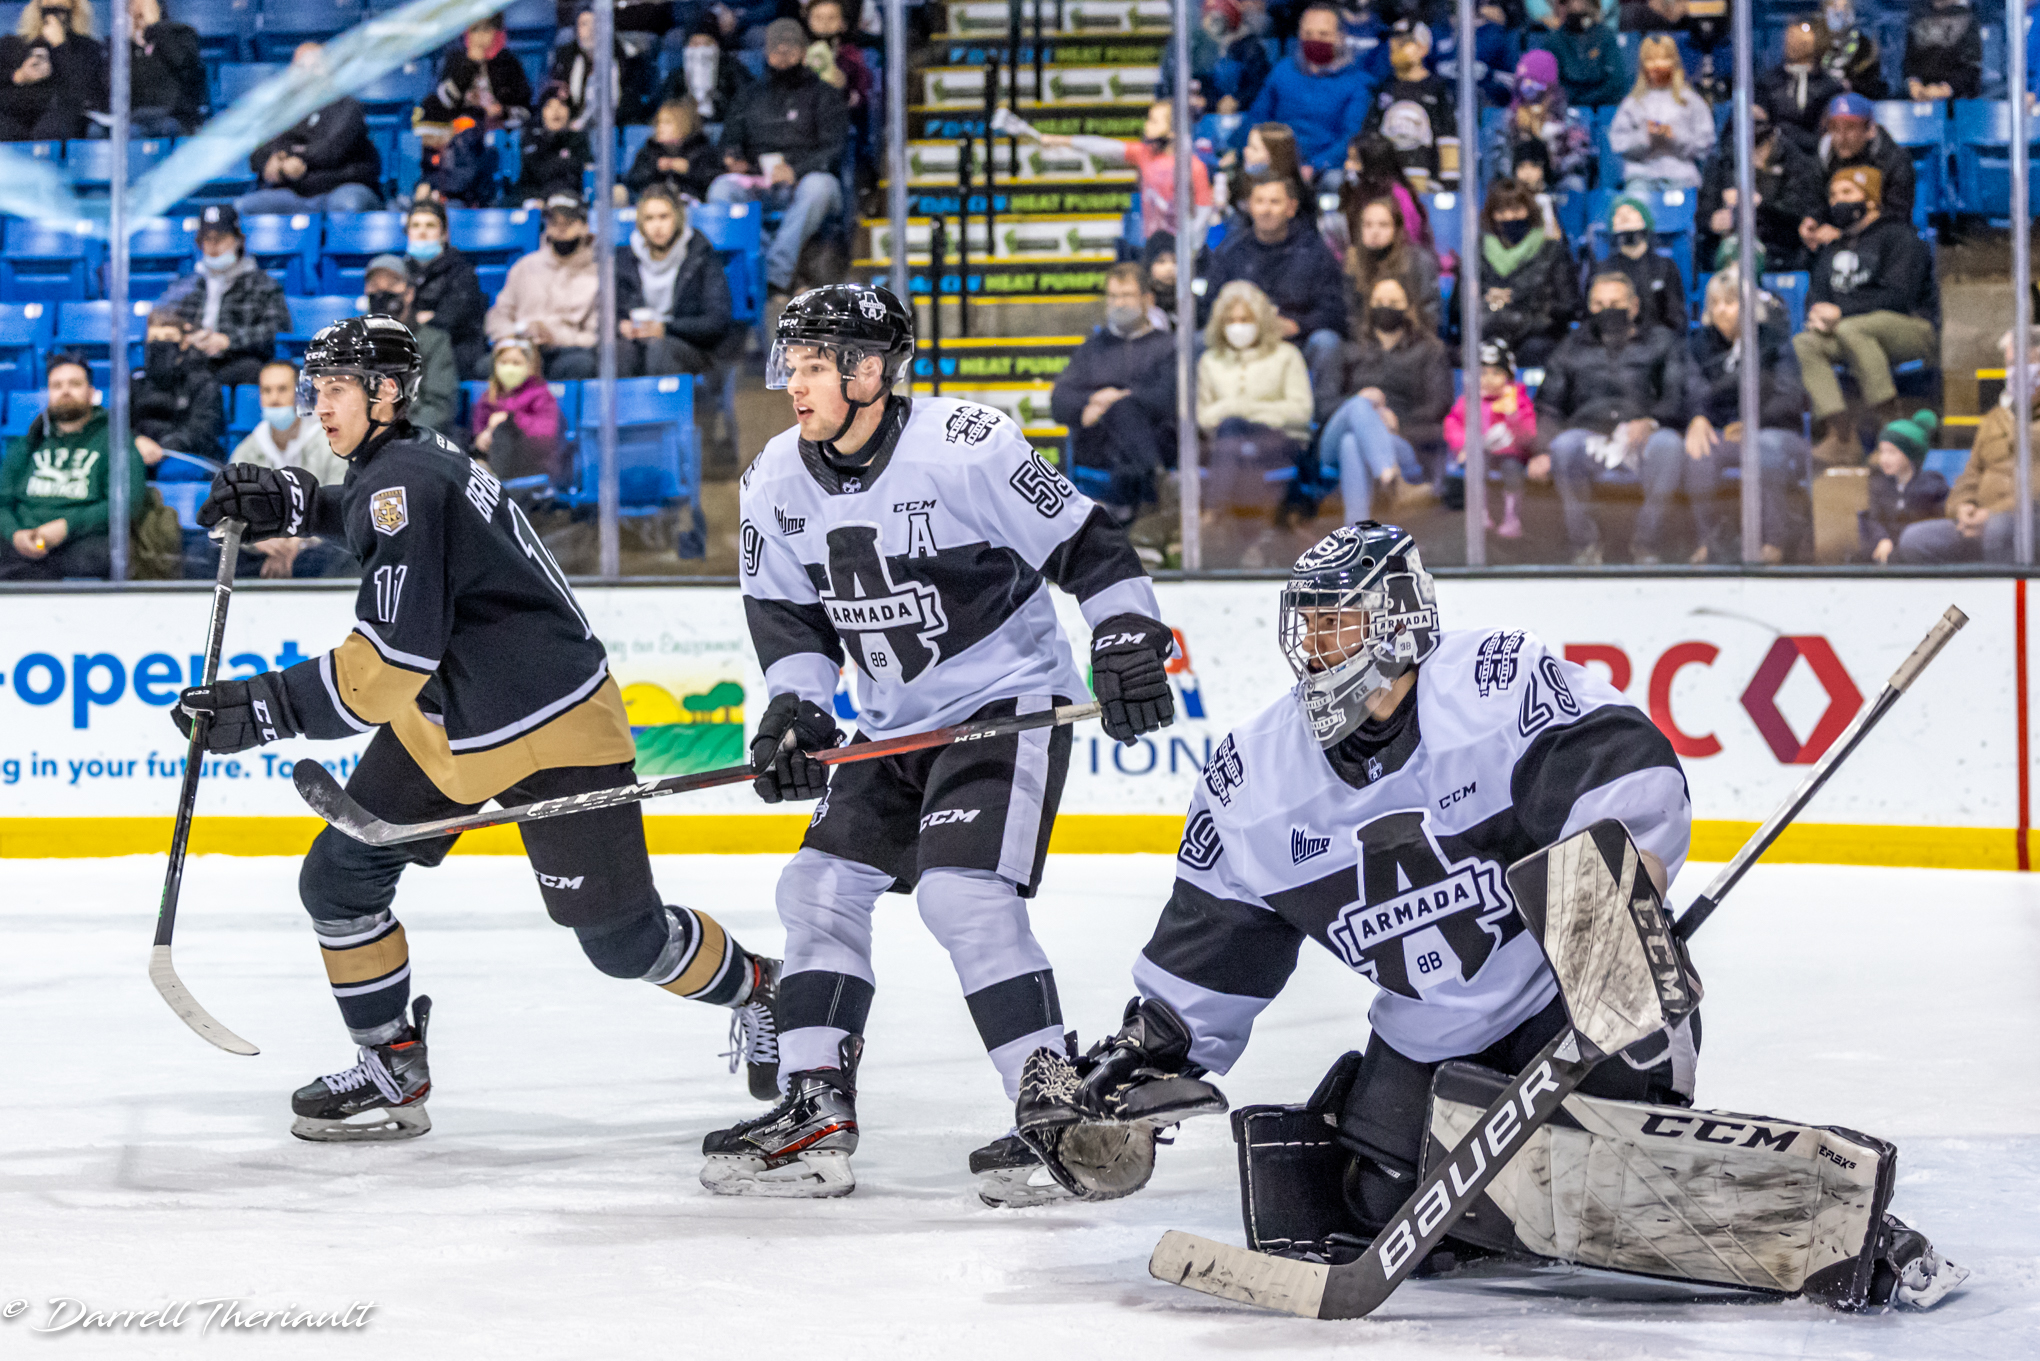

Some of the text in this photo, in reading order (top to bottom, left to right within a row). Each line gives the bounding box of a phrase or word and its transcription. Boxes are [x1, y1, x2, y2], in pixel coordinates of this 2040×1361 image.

[465, 457, 502, 523] BRIB
[893, 499, 937, 513] CCM
[908, 512, 938, 559] A
[374, 565, 408, 624] 11
[833, 602, 912, 623] ARMADA
[1091, 632, 1146, 651] CM
[31, 751, 58, 777] in
[67, 758, 138, 785] your
[1075, 737, 1213, 776] ION
[1439, 781, 1476, 810] CCM
[919, 809, 981, 834] CCM
[1362, 883, 1469, 939] ARMADA
[1632, 898, 1686, 1001] CCM
[1641, 1113, 1800, 1153] CCM
